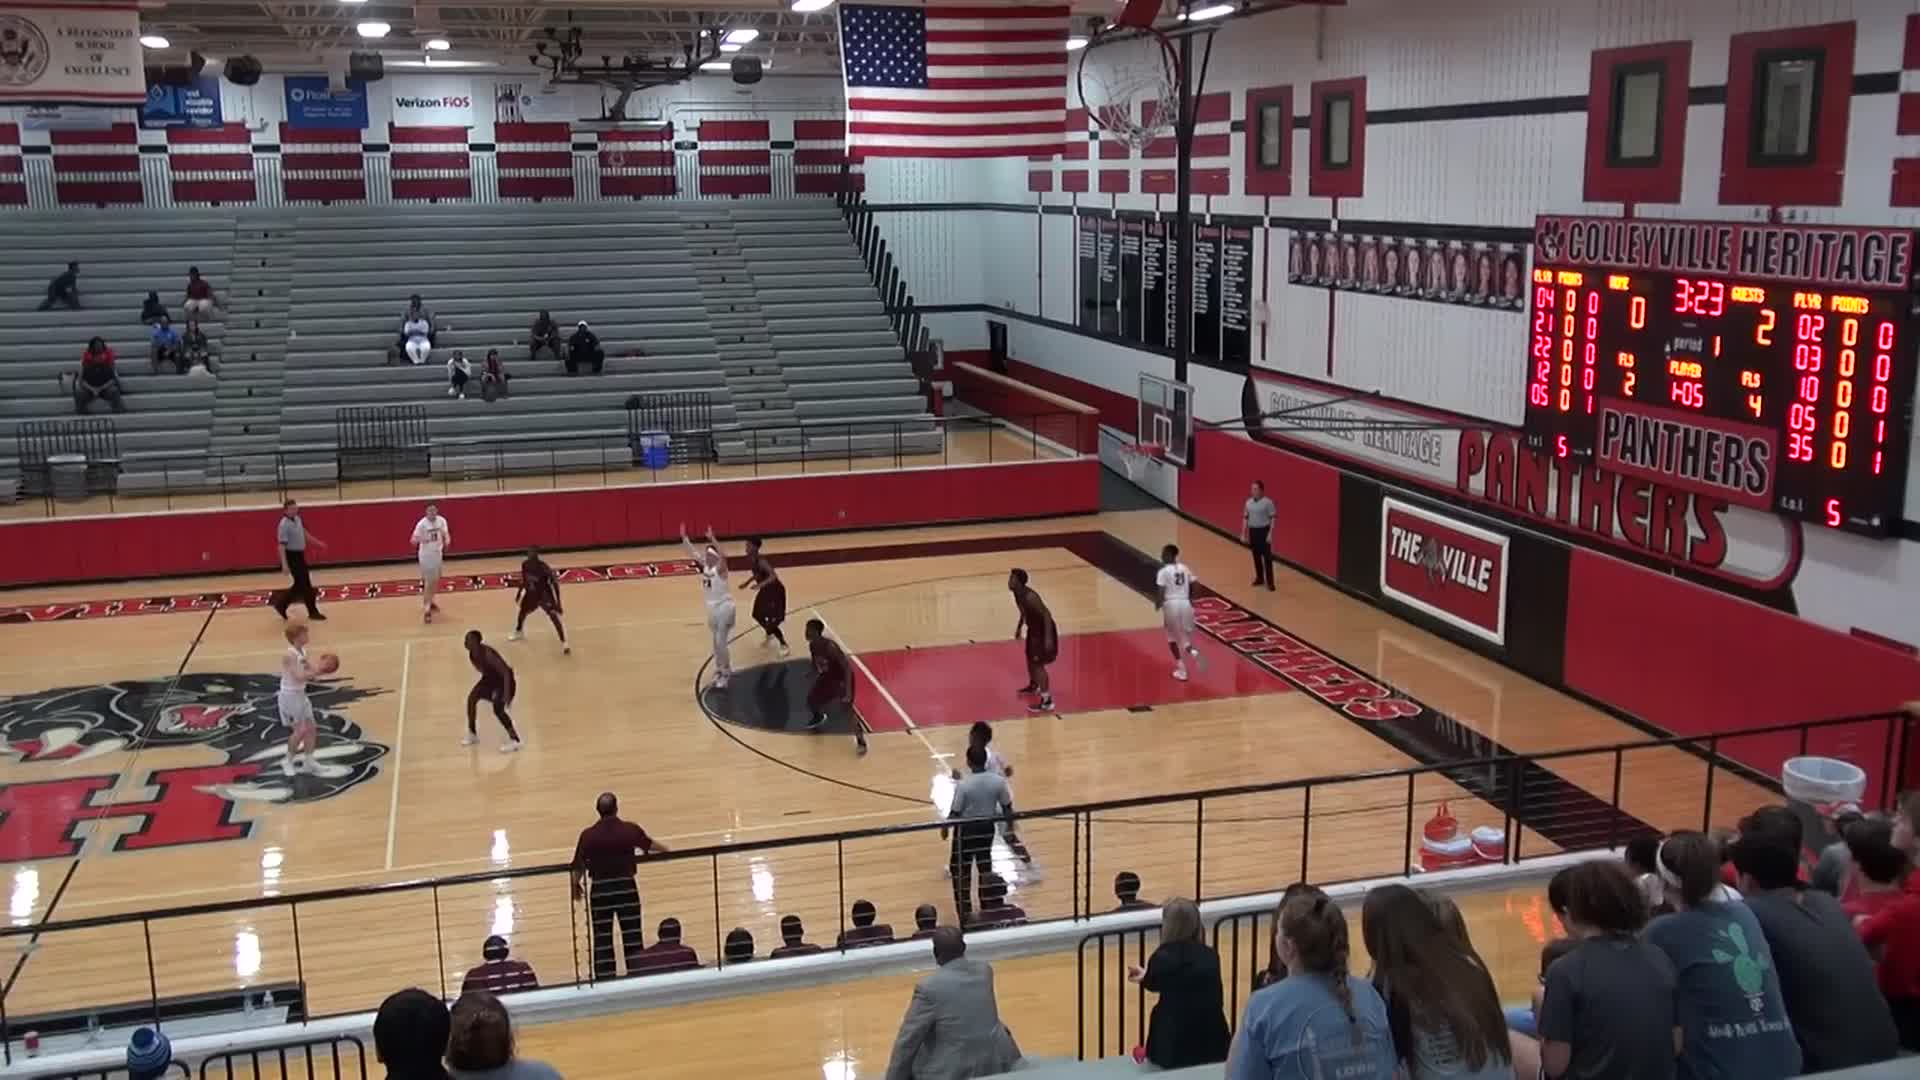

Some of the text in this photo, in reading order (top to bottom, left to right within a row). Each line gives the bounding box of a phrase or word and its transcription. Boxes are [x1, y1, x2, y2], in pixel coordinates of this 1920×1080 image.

[396, 96, 470, 108] Verizon FiOS
[1567, 221, 1731, 272] COLLEYVILLE
[1740, 226, 1909, 287] HERITAGE
[1536, 287, 1598, 314] 04 0 0
[1675, 279, 1724, 316] 3:23
[1731, 286, 1765, 304] GUESTS
[1794, 292, 1869, 314] PLYR POINTS
[1535, 311, 1597, 340] 21 0 0
[1630, 296, 1645, 329] 0
[1757, 309, 1775, 345] 2
[1674, 335, 1721, 357] period 1
[1798, 314, 1894, 350] 02 0 0
[1534, 336, 1595, 365] 22 0 0
[1795, 344, 1890, 382] 03 0 0
[1538, 361, 1594, 390] 12 0 0
[1624, 371, 1635, 396] 2
[1670, 360, 1702, 378] PLAYER
[1531, 383, 1593, 414] 05 0 1
[1748, 394, 1762, 418] 4
[1800, 375, 1887, 412] 10 0 0
[1790, 403, 1884, 443] 05 0 1
[1363, 416, 1442, 467] HERITAGE
[1558, 435, 1567, 458] 5
[1601, 408, 1770, 497] PANTHERS
[1788, 433, 1882, 474] 35 0 1
[1456, 427, 1728, 569] PANTHERS
[1827, 499, 1841, 527] 5
[1391, 525, 1492, 593] THE VILLE
[1192, 597, 1422, 721] PANTHERS
